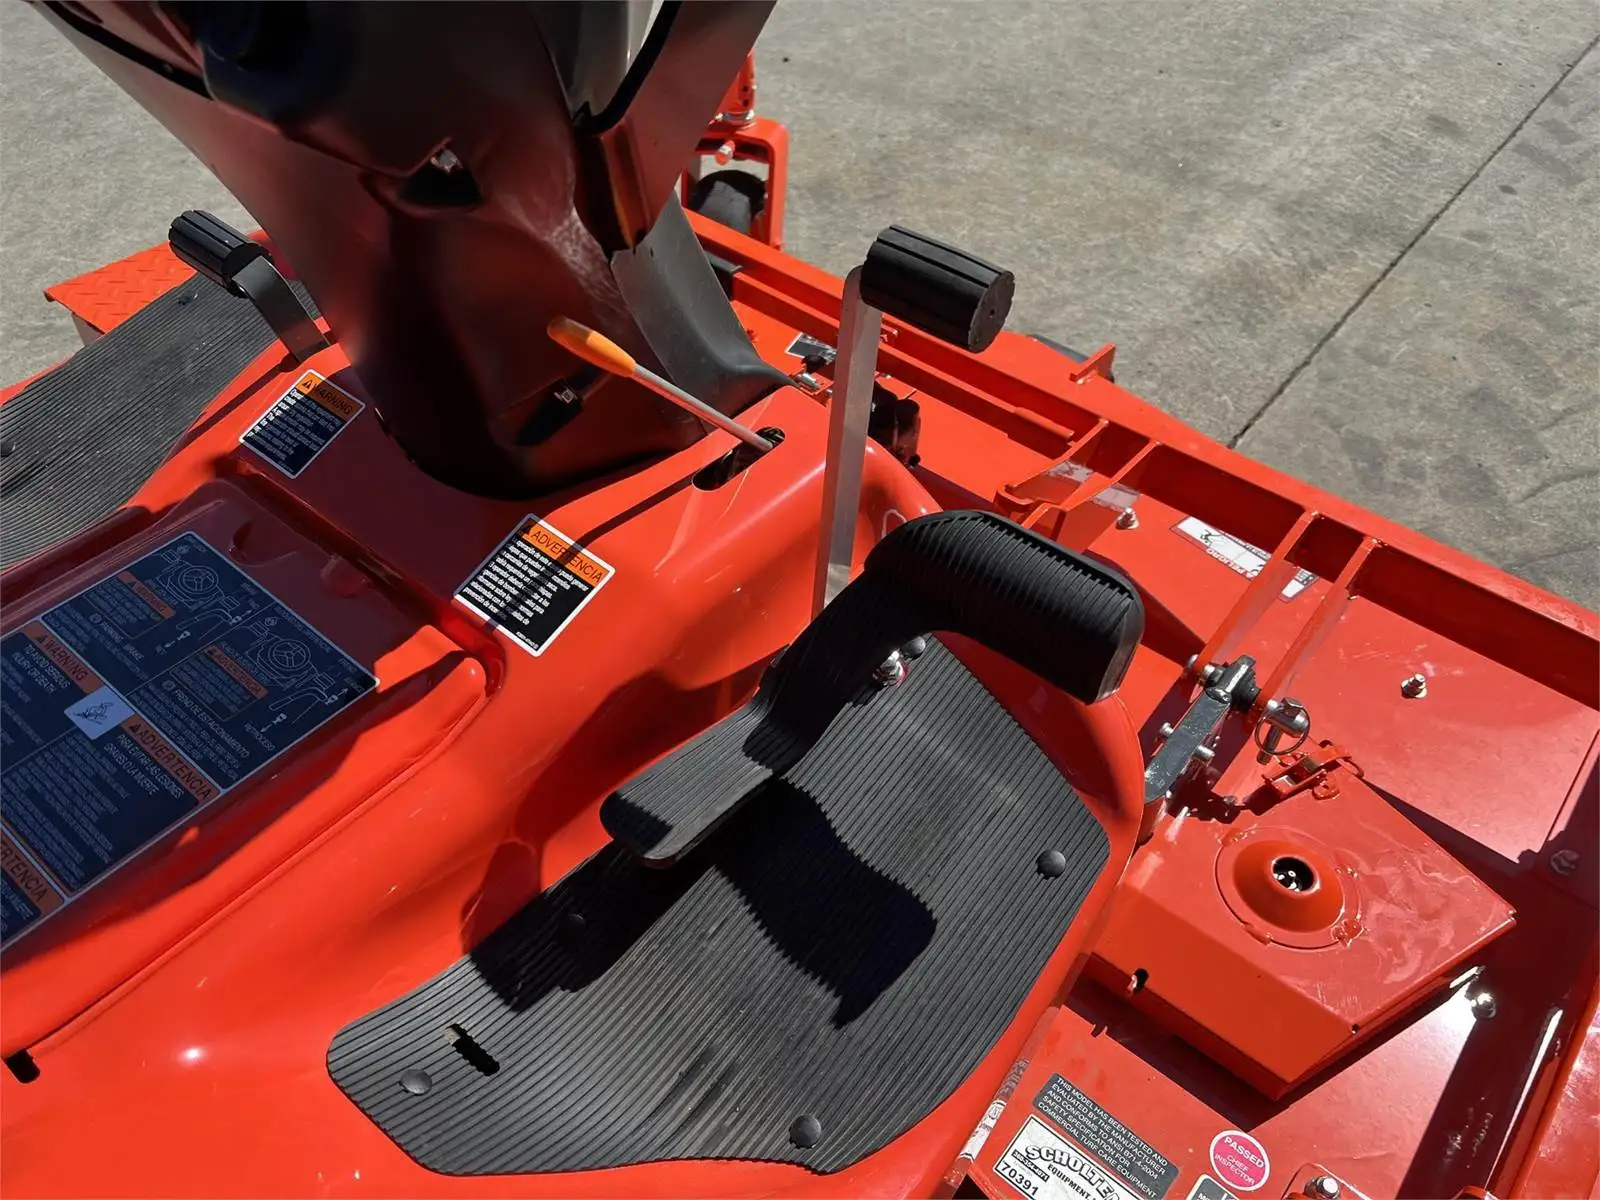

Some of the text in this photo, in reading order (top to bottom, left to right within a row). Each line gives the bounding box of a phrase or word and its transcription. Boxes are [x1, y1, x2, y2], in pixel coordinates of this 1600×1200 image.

[312, 382, 353, 416] WARNING
[532, 530, 603, 583] ADVERTENCIA
[42, 639, 89, 681] WARNING
[134, 727, 213, 800] ADVERTENCIA
[0, 840, 48, 902] RTENCIA
[1037, 1100, 1156, 1199] COMMERCIAL TURF CARE EQUIPMENT
[1041, 1094, 1130, 1168] SAFETY SPECIFICATION FOR
[1046, 1089, 1158, 1180] AND CONFORMS TO ANSI B71.4-2004
[1051, 1082, 1166, 1175] EVALUATED BY THE MANUFACTURER
[1056, 1076, 1168, 1167] THIS MODEL HAS BEEN TESTED AND
[1001, 1161, 1039, 1196] 70391
[1214, 1153, 1256, 1186] INSPECTOR
[1223, 1135, 1265, 1169] PASSED
[1226, 1154, 1248, 1172] CHIEF
